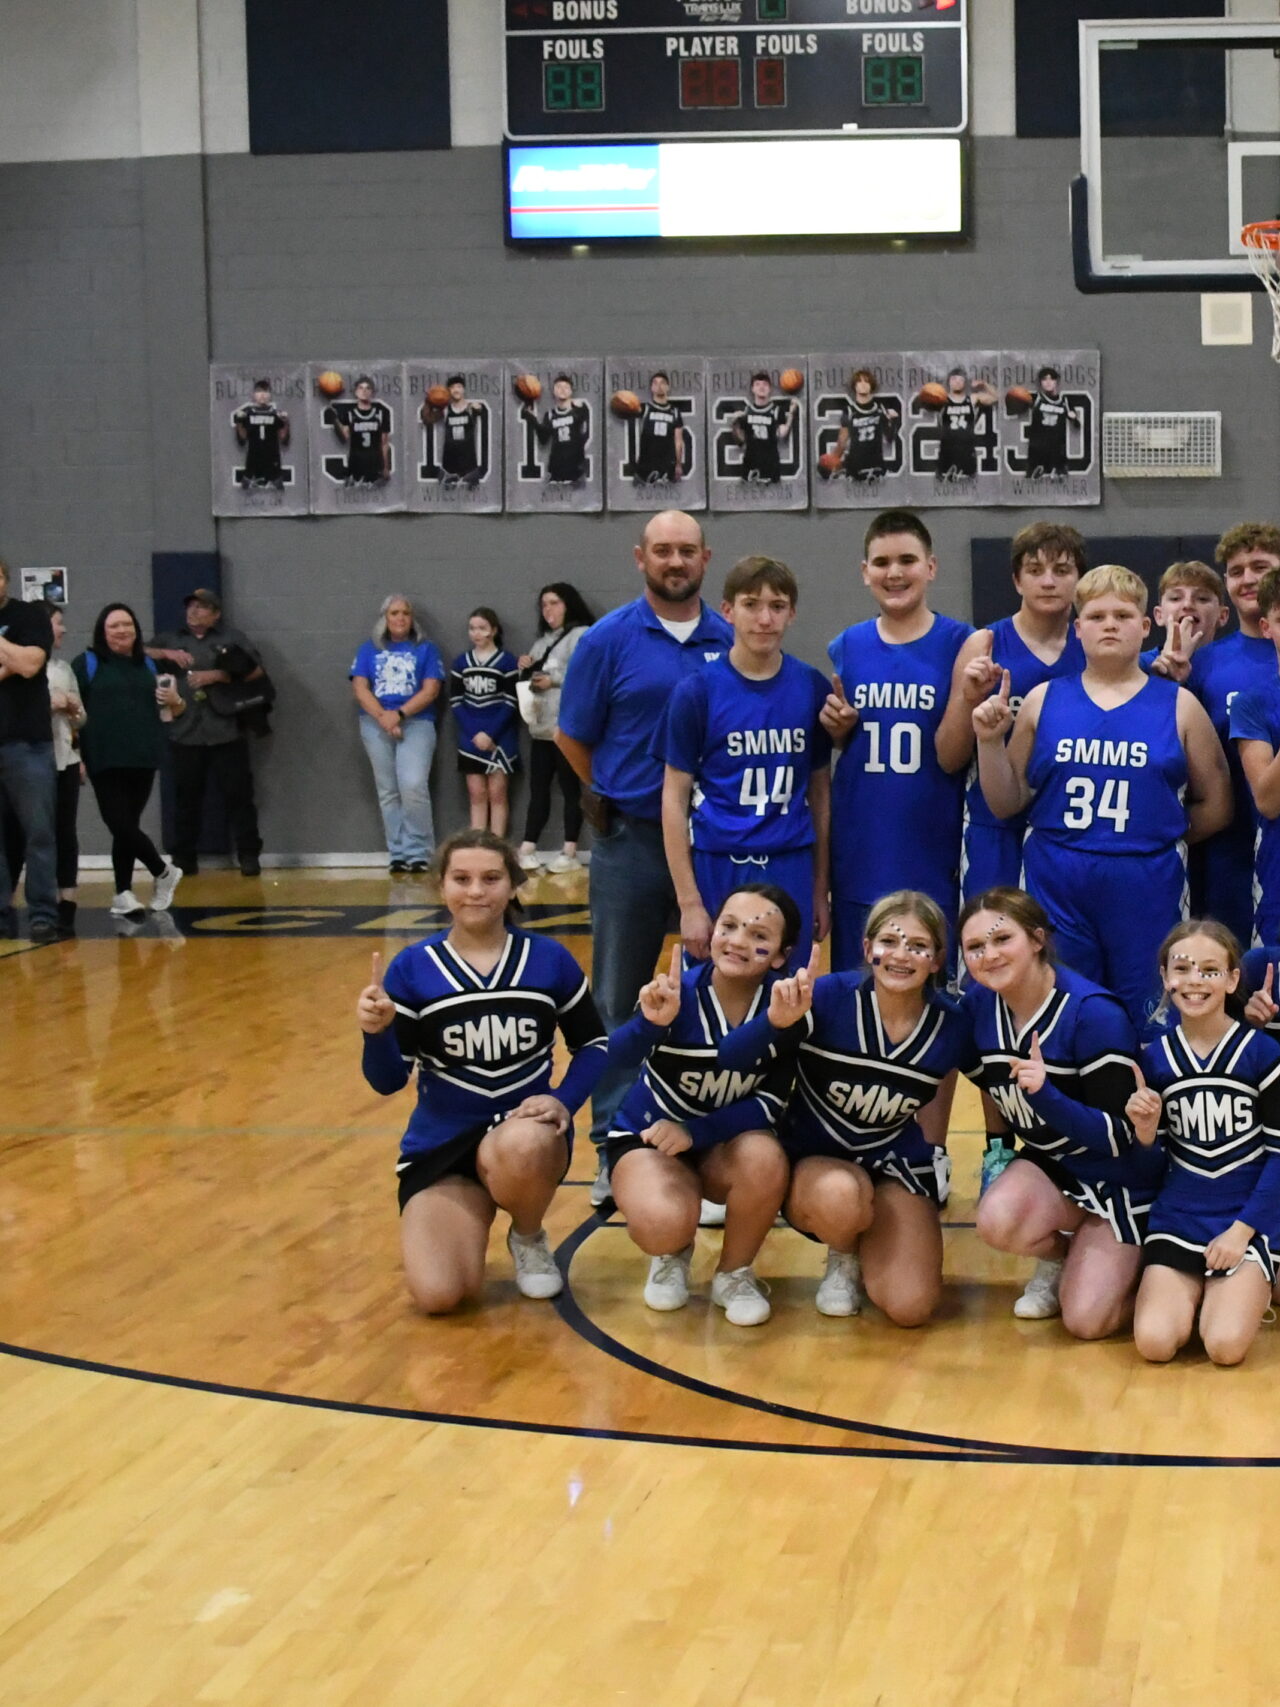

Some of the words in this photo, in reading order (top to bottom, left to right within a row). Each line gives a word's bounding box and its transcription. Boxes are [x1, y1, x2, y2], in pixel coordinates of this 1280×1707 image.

[553, 0, 618, 20] BONUS
[846, 0, 912, 14] BONUS
[543, 39, 604, 59] FOULS
[666, 36, 739, 57] PLAYER
[756, 33, 818, 54] FOULS
[862, 31, 924, 53] FOULS
[463, 676, 496, 692] SMMS
[854, 683, 936, 711] SMMS
[727, 728, 806, 757] SMMS
[863, 721, 922, 774] 10
[1054, 738, 1148, 768] SMMS
[739, 766, 795, 816] 44
[1063, 776, 1130, 833] 34
[443, 1014, 538, 1062] SMMS
[679, 1069, 766, 1107] SMM
[826, 1081, 920, 1124] SMMS
[1166, 1090, 1254, 1142] SMMS
